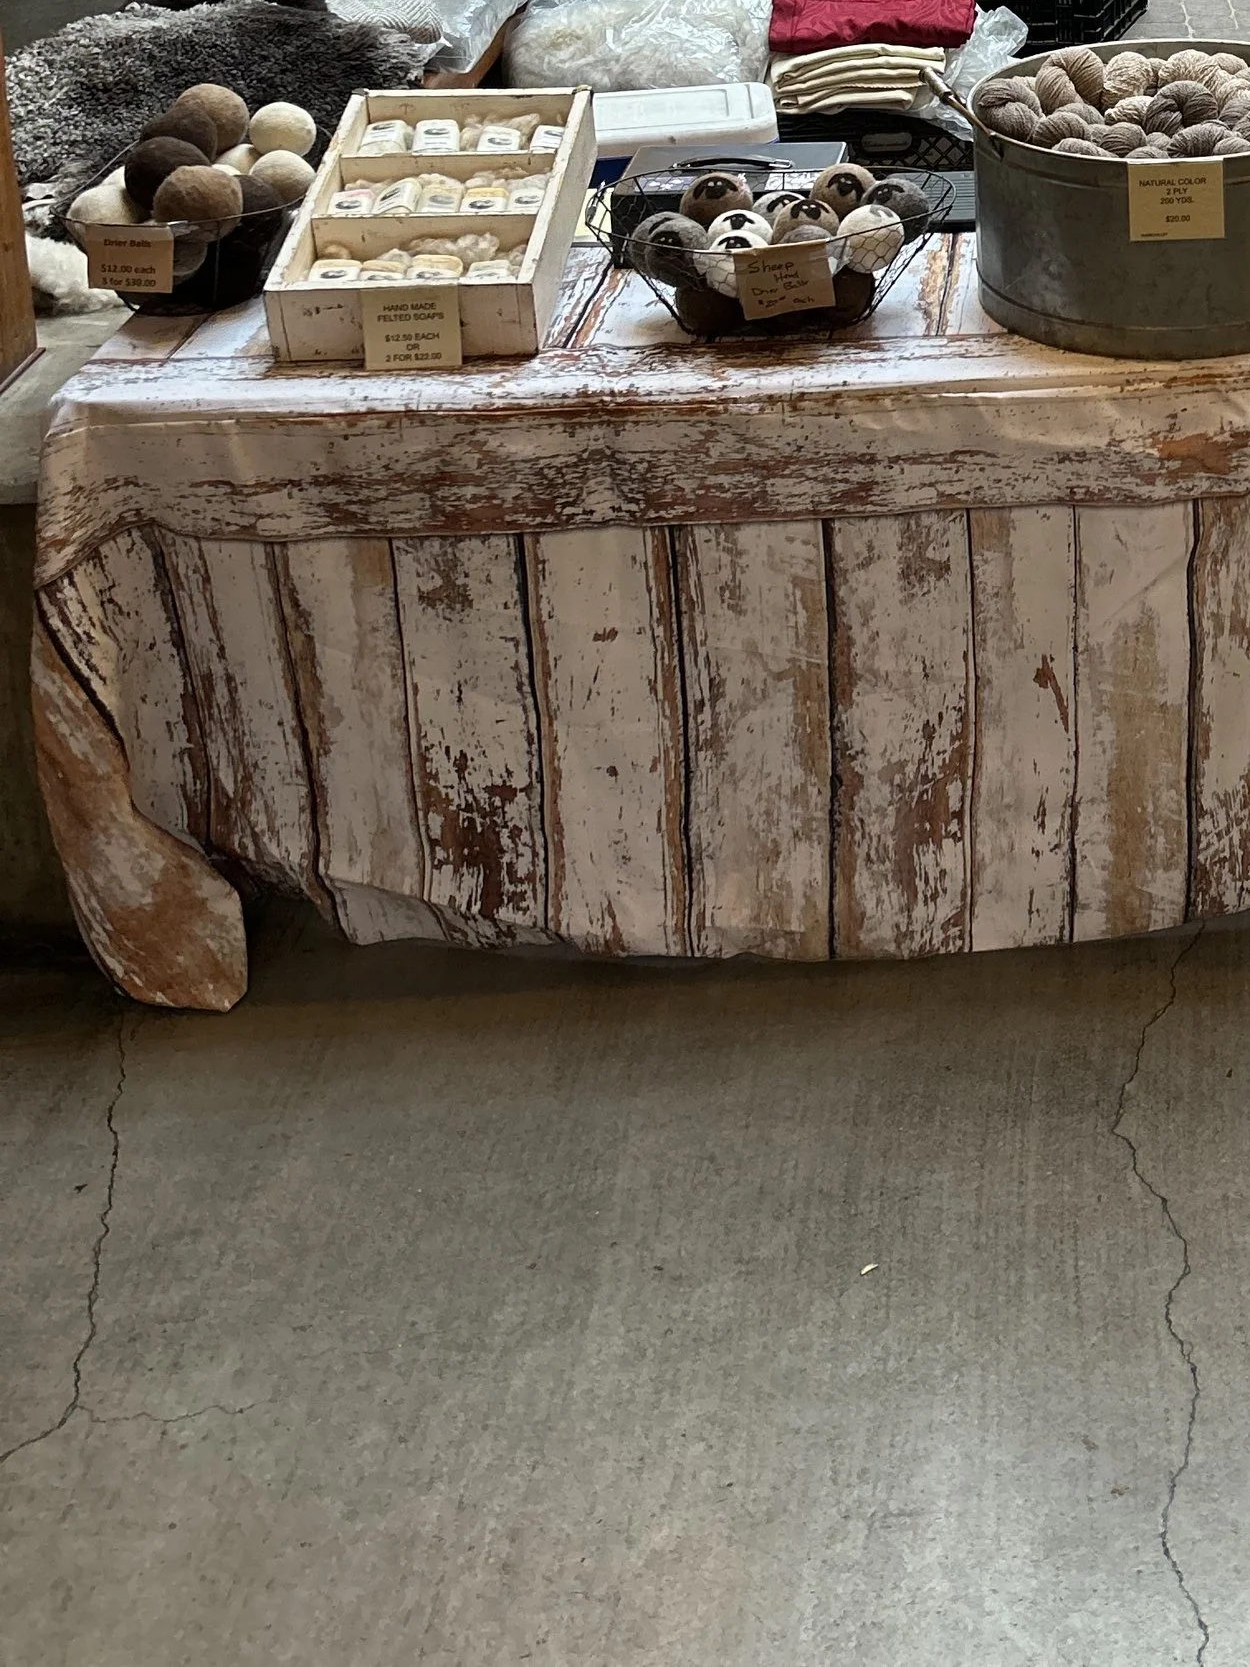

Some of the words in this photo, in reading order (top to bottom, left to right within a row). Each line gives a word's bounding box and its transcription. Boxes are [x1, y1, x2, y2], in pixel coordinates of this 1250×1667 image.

[1139, 178, 1175, 187] NATURAL
[1177, 177, 1207, 186] COLOR
[1173, 187, 1188, 195] PLY
[1160, 197, 1174, 205] 200
[1165, 215, 1191, 223] $20.00
[101, 264, 133, 273] $12.00
[134, 265, 156, 274] each
[747, 260, 795, 274] Sheep
[109, 277, 123, 286] for
[383, 303, 409, 312] HAND
[411, 302, 437, 311] MADE
[376, 313, 412, 323] FELTED
[413, 312, 445, 321] SOAPS
[414, 332, 440, 341] EACH
[406, 343, 420, 351] OR
[393, 353, 412, 362] FOR
